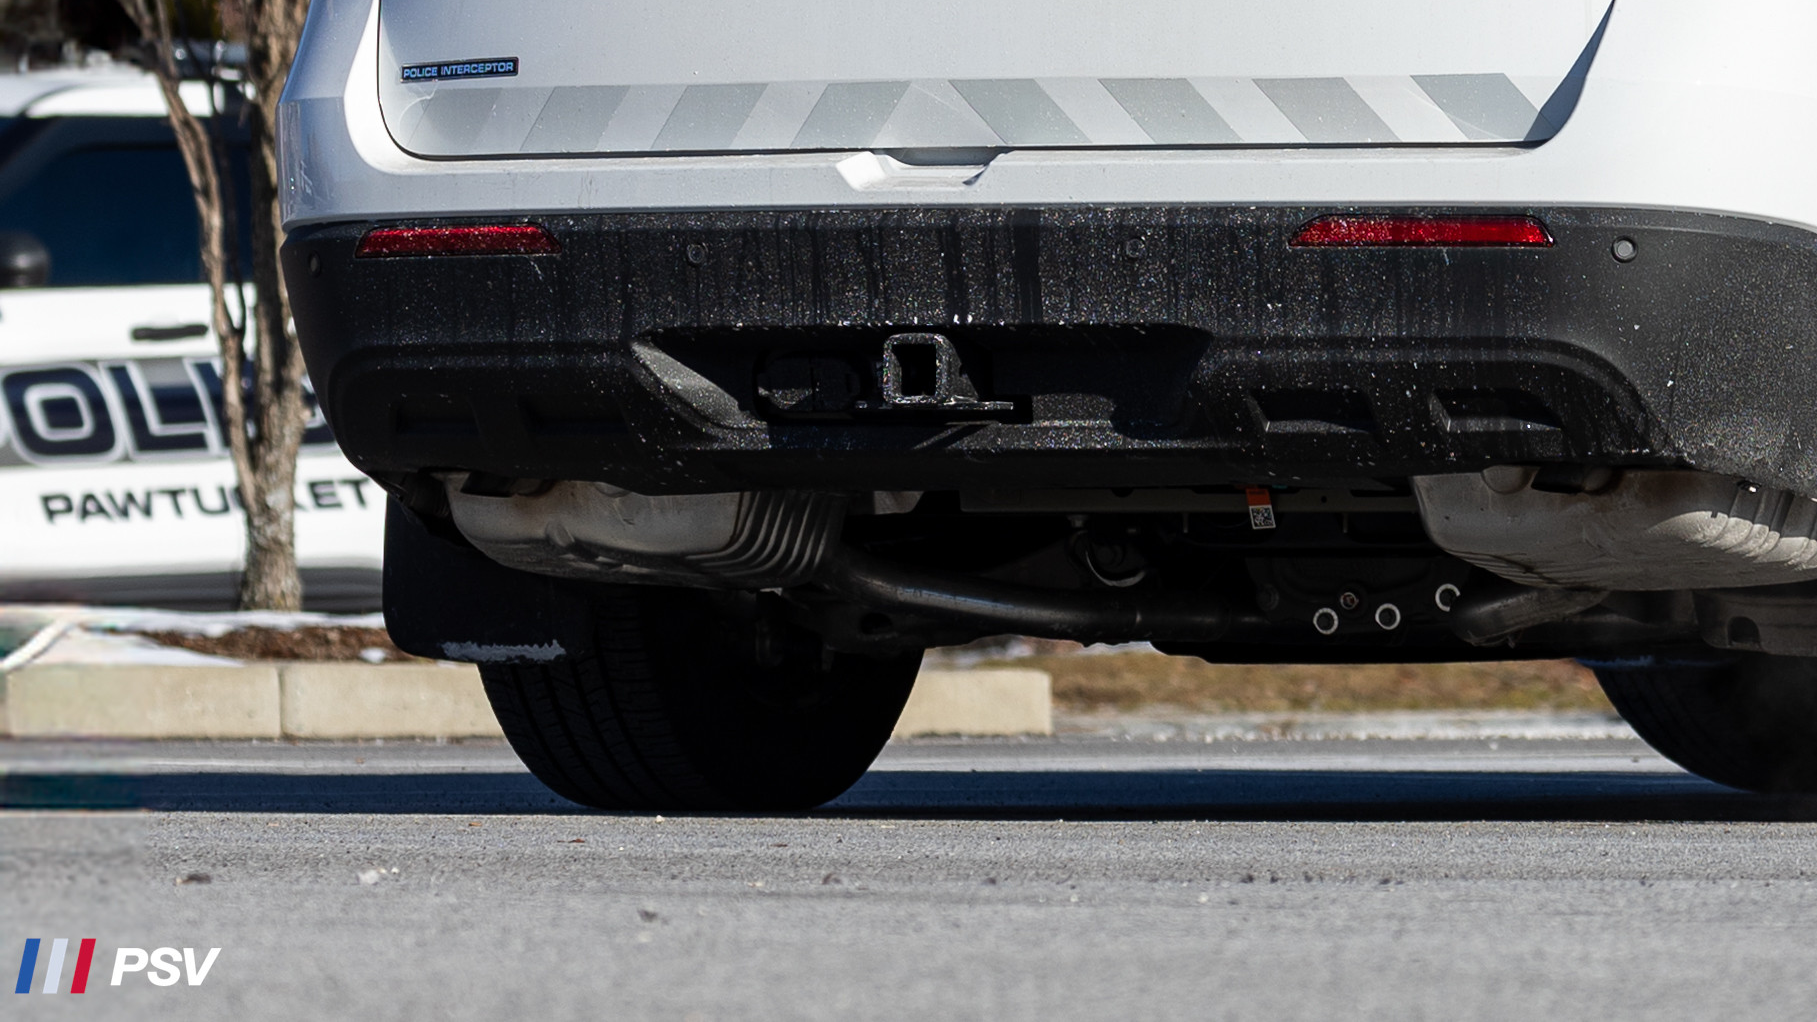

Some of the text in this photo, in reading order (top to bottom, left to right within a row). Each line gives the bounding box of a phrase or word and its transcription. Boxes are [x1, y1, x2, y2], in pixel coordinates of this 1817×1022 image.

[403, 62, 514, 78] POLICE INTERCEPTOR
[40, 477, 371, 525] PAWTUET
